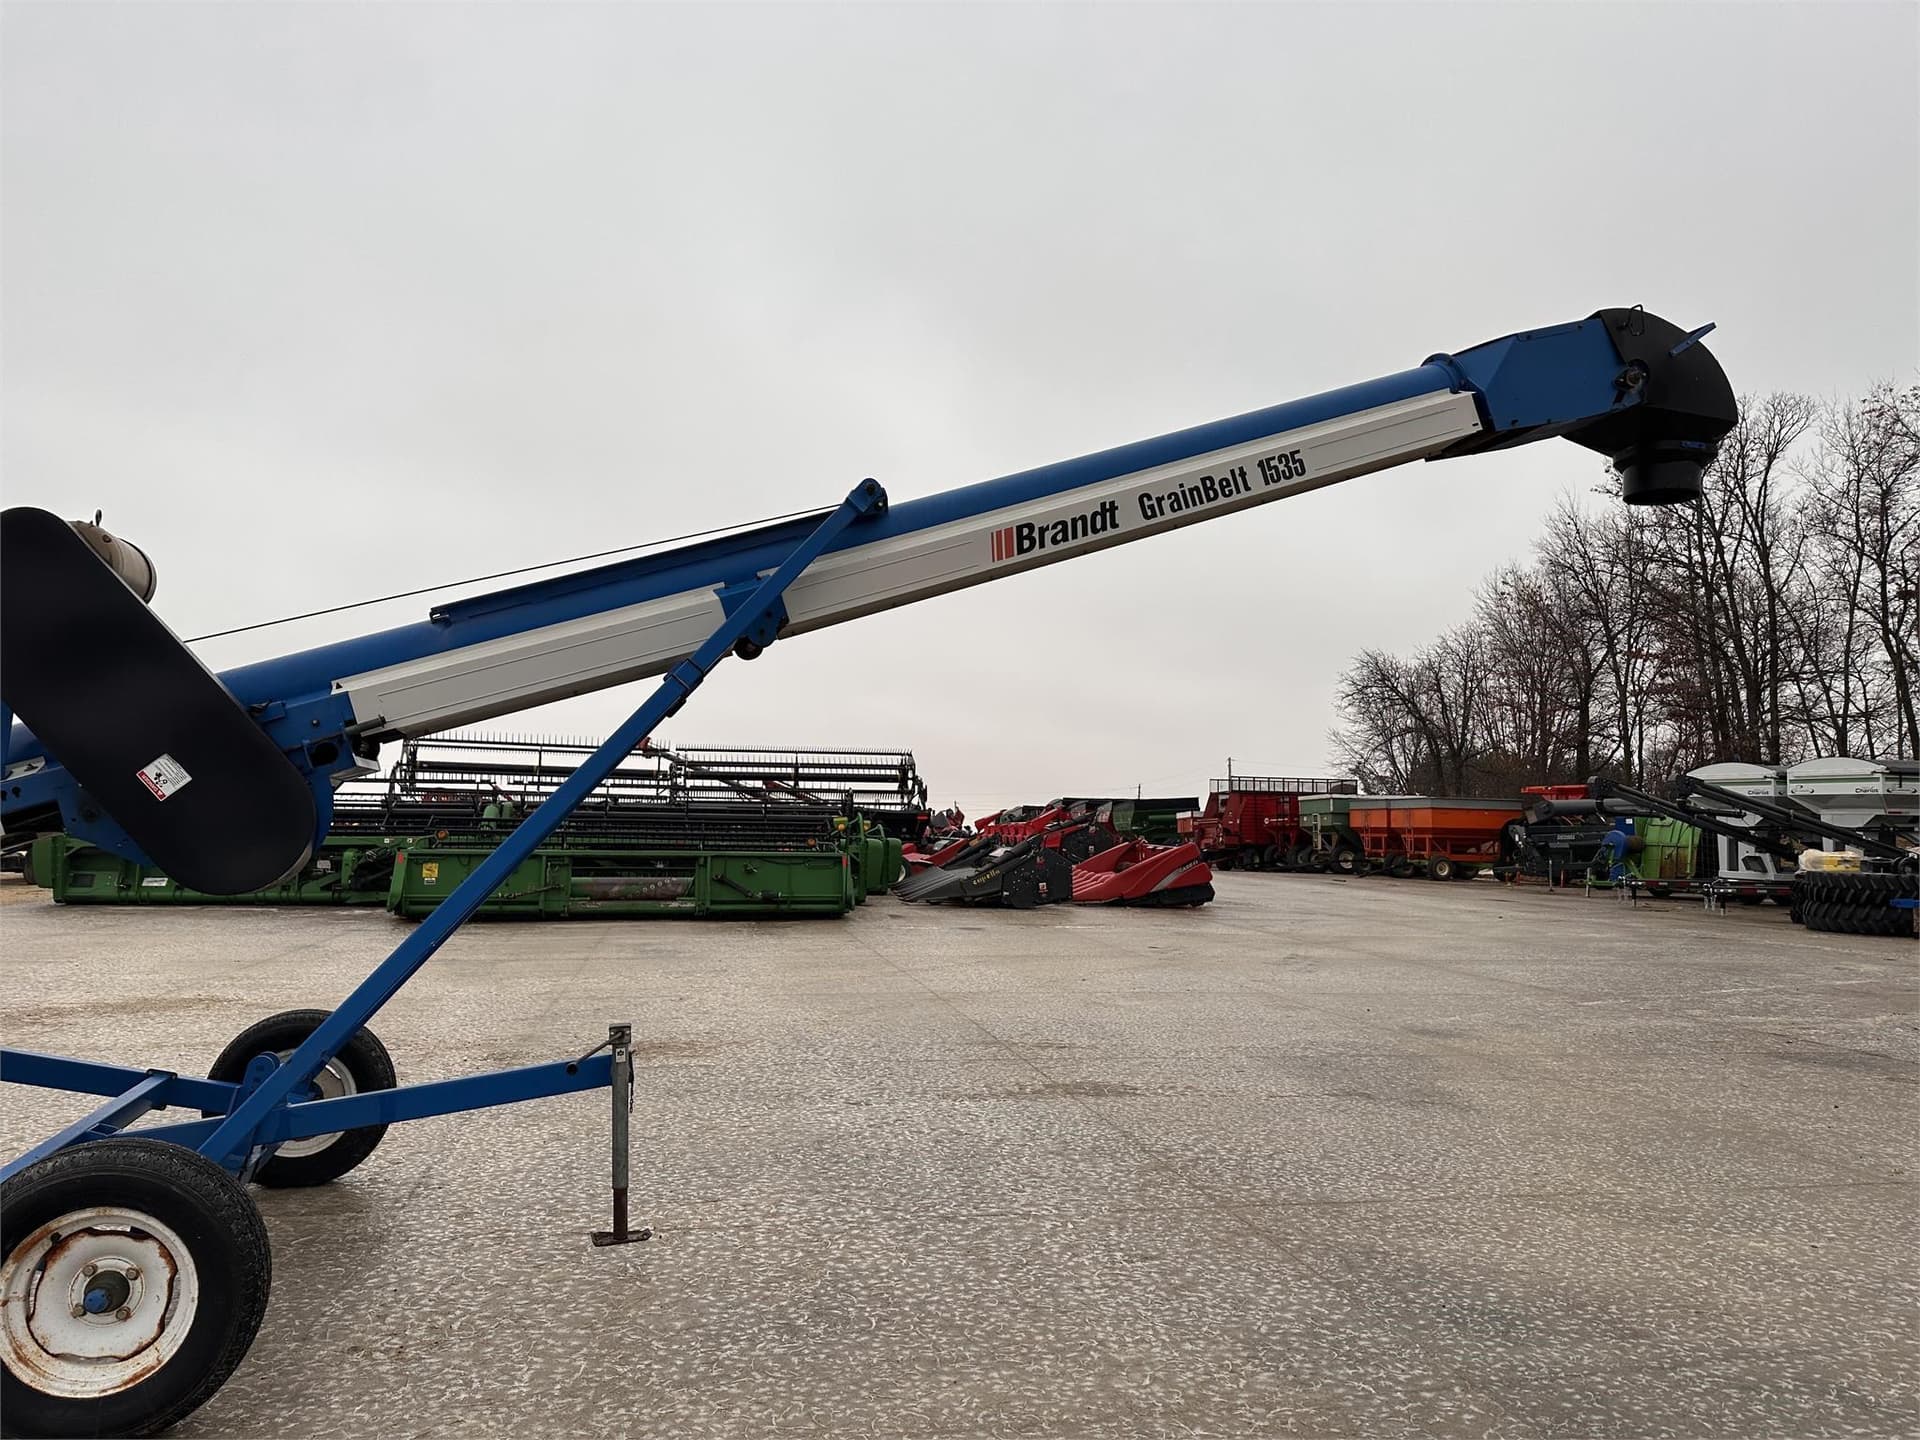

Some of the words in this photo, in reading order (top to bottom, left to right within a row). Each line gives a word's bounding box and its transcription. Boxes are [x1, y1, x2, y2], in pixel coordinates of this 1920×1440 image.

[1015, 500, 1119, 556] Brandt
[1138, 465, 1251, 521] GrainBelt
[1256, 449, 1306, 487] 1535
